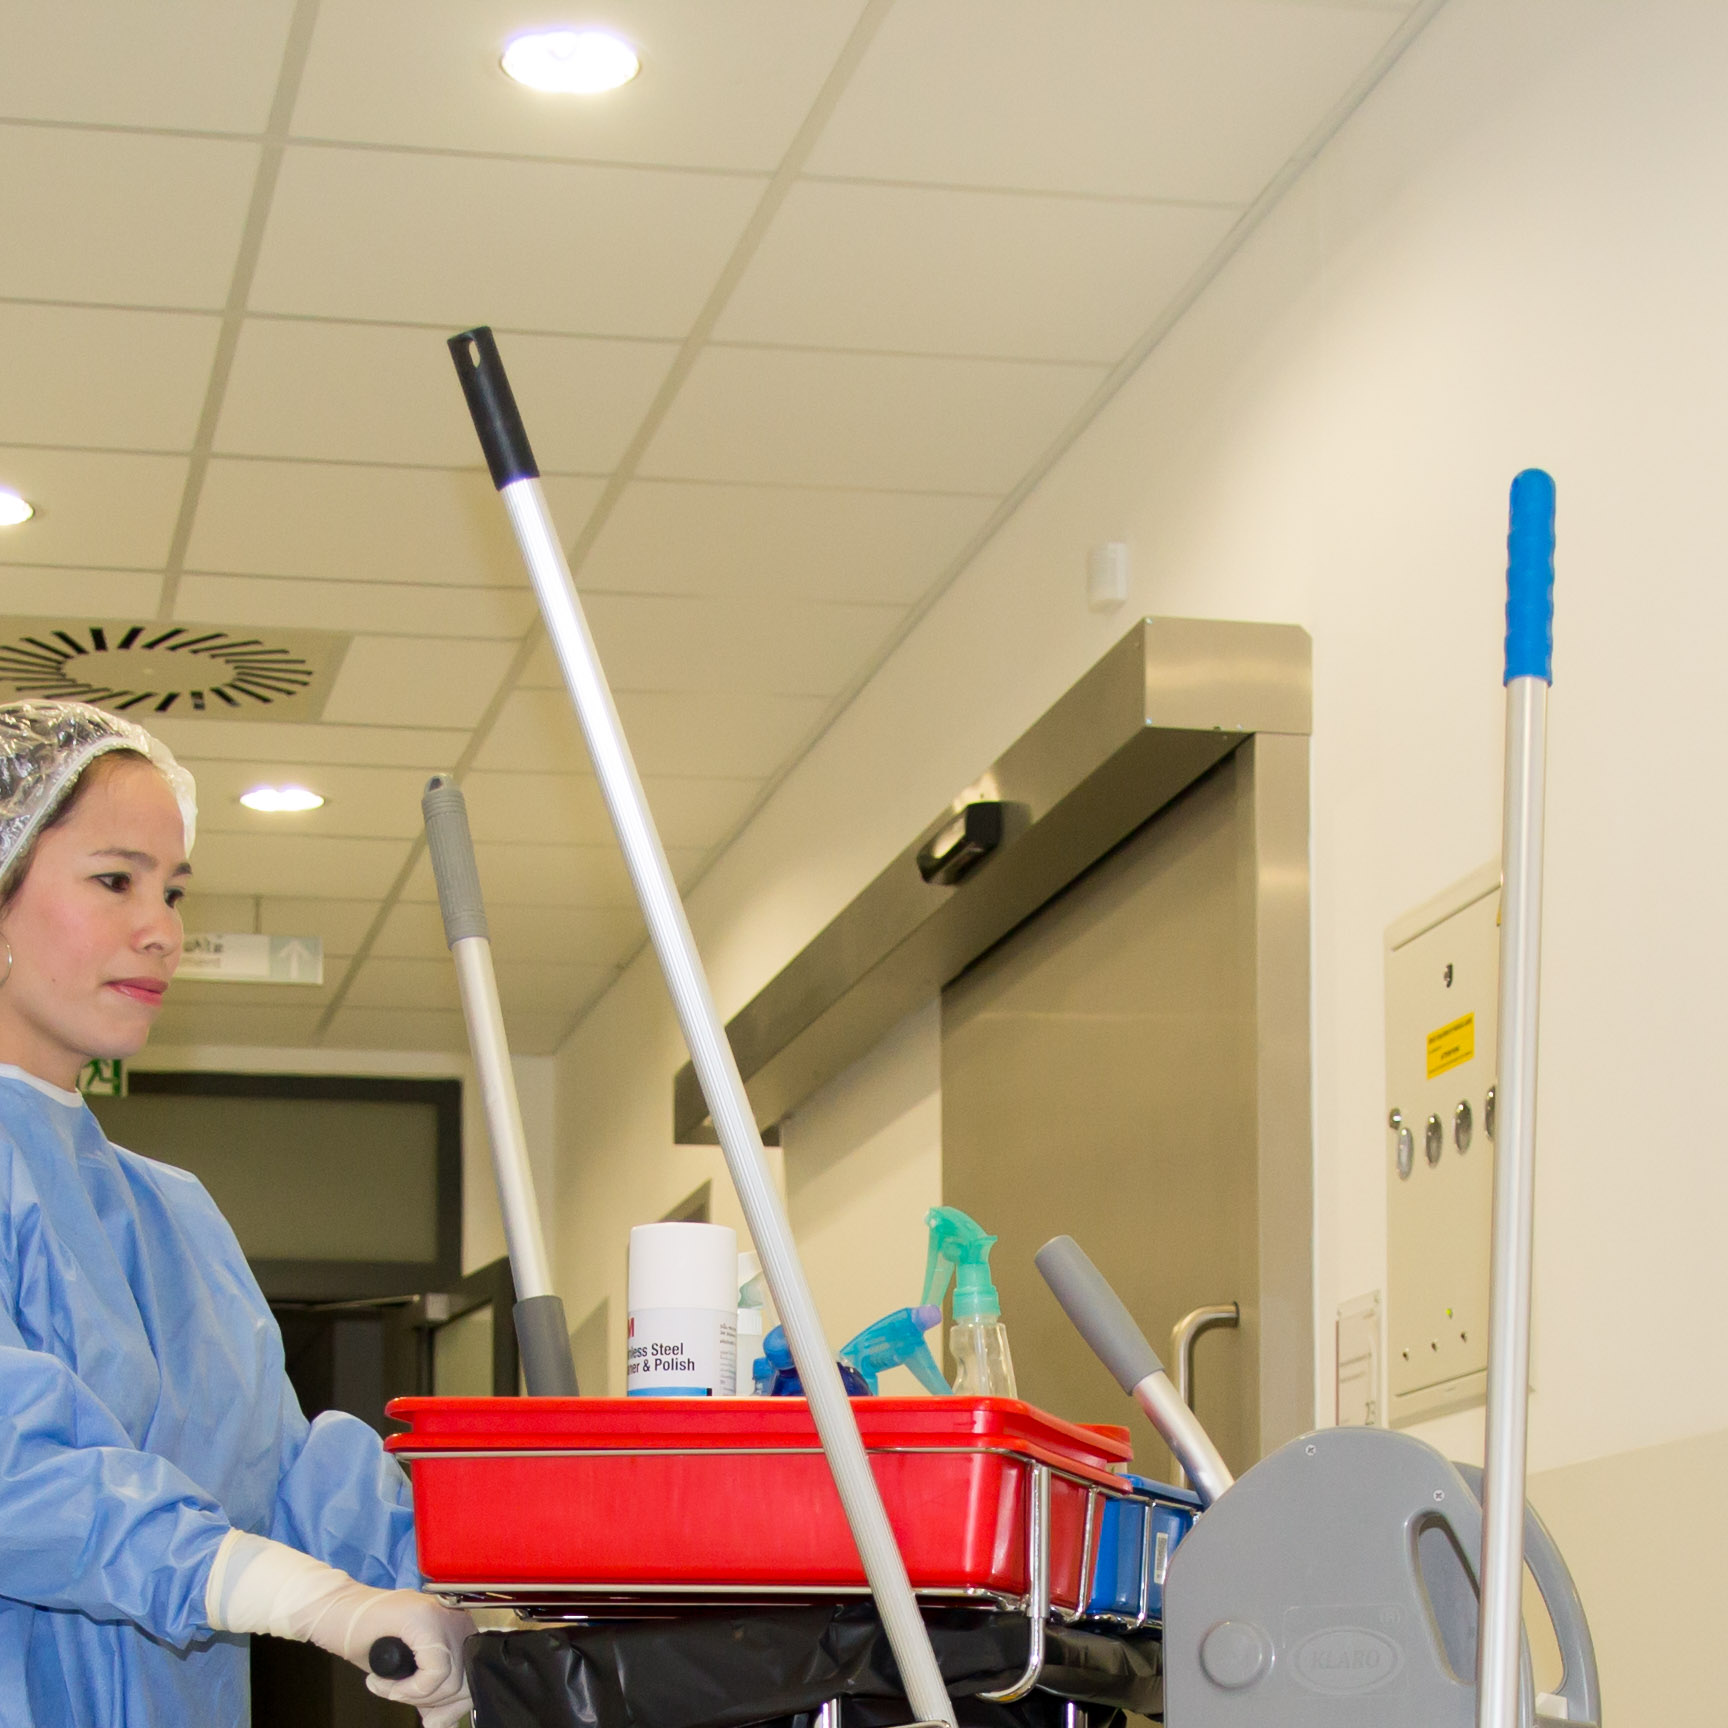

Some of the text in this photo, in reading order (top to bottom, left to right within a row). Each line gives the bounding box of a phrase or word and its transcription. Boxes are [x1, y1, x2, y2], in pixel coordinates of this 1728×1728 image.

[651, 1342, 683, 1356] Steel
[642, 1358, 650, 1372] &
[654, 1357, 695, 1371] Polish
[1311, 1649, 1381, 1671] KLARO
